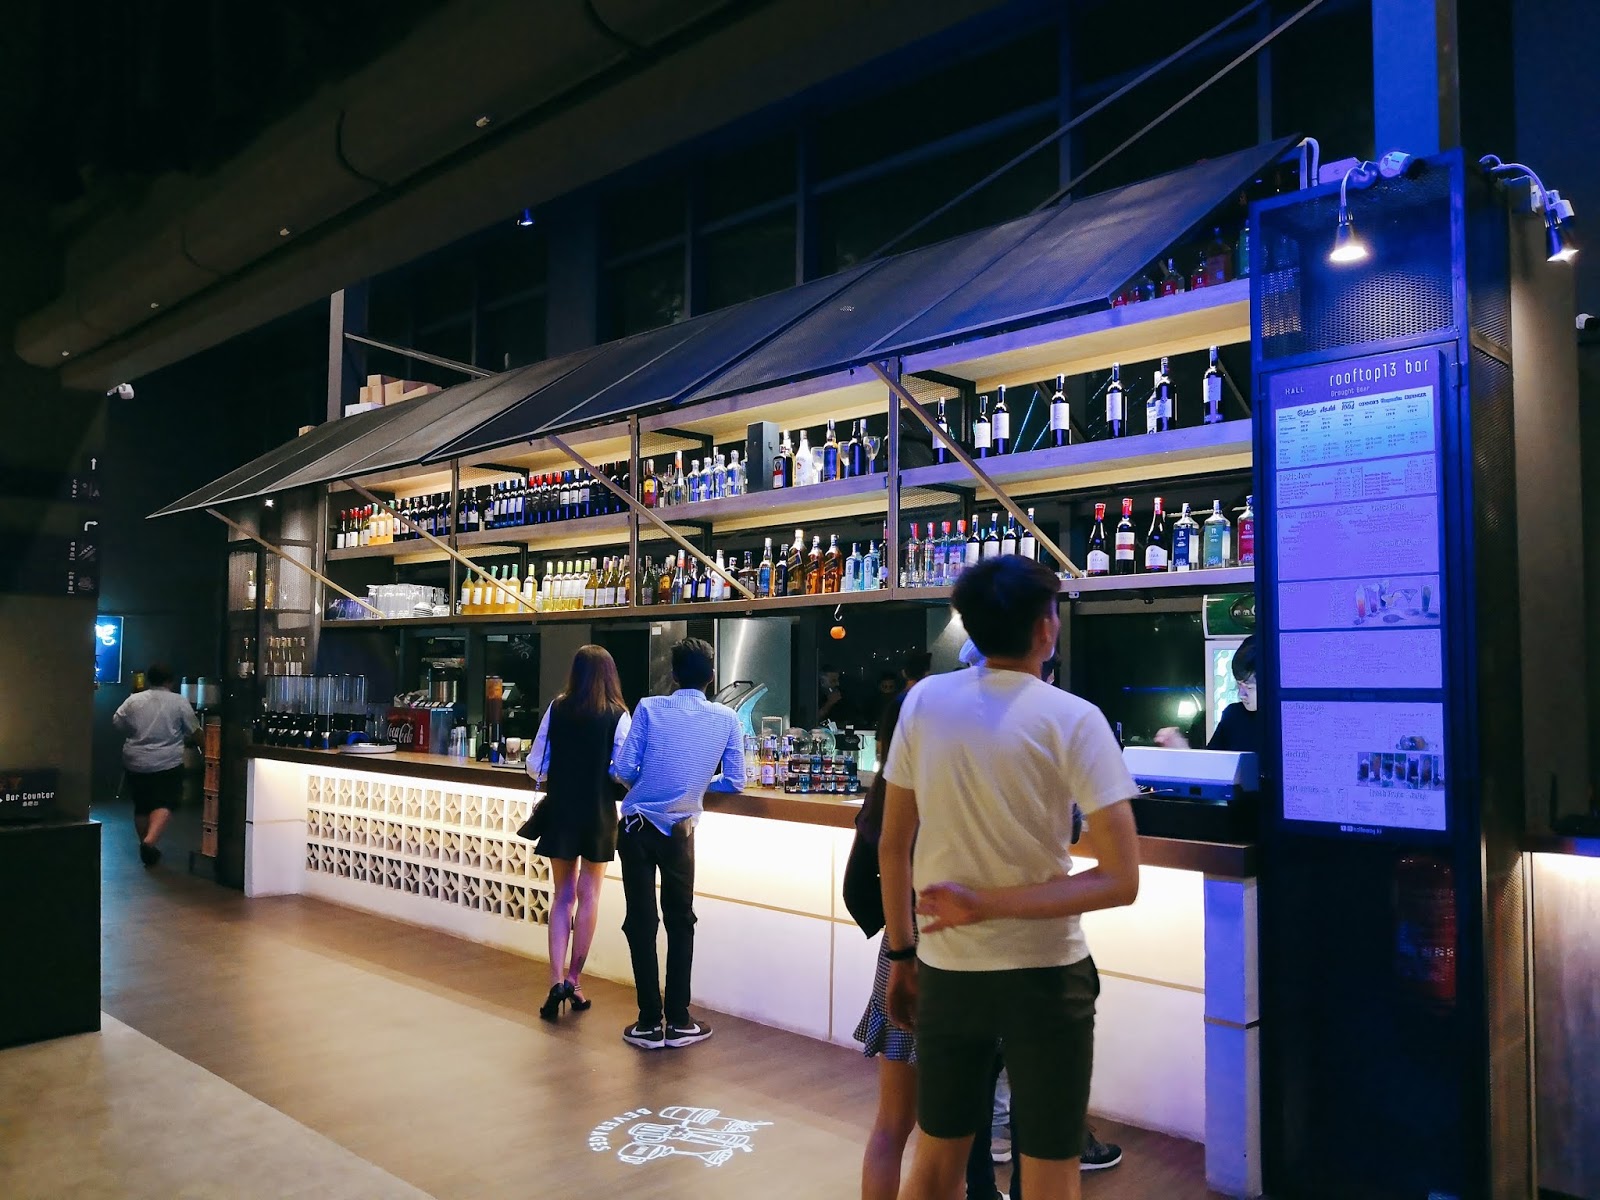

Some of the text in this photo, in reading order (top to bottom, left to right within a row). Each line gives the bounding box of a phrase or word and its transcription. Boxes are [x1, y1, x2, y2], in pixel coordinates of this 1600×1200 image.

[1329, 359, 1429, 387] rooftop13 bar
[5, 791, 55, 801] Bar Counter
